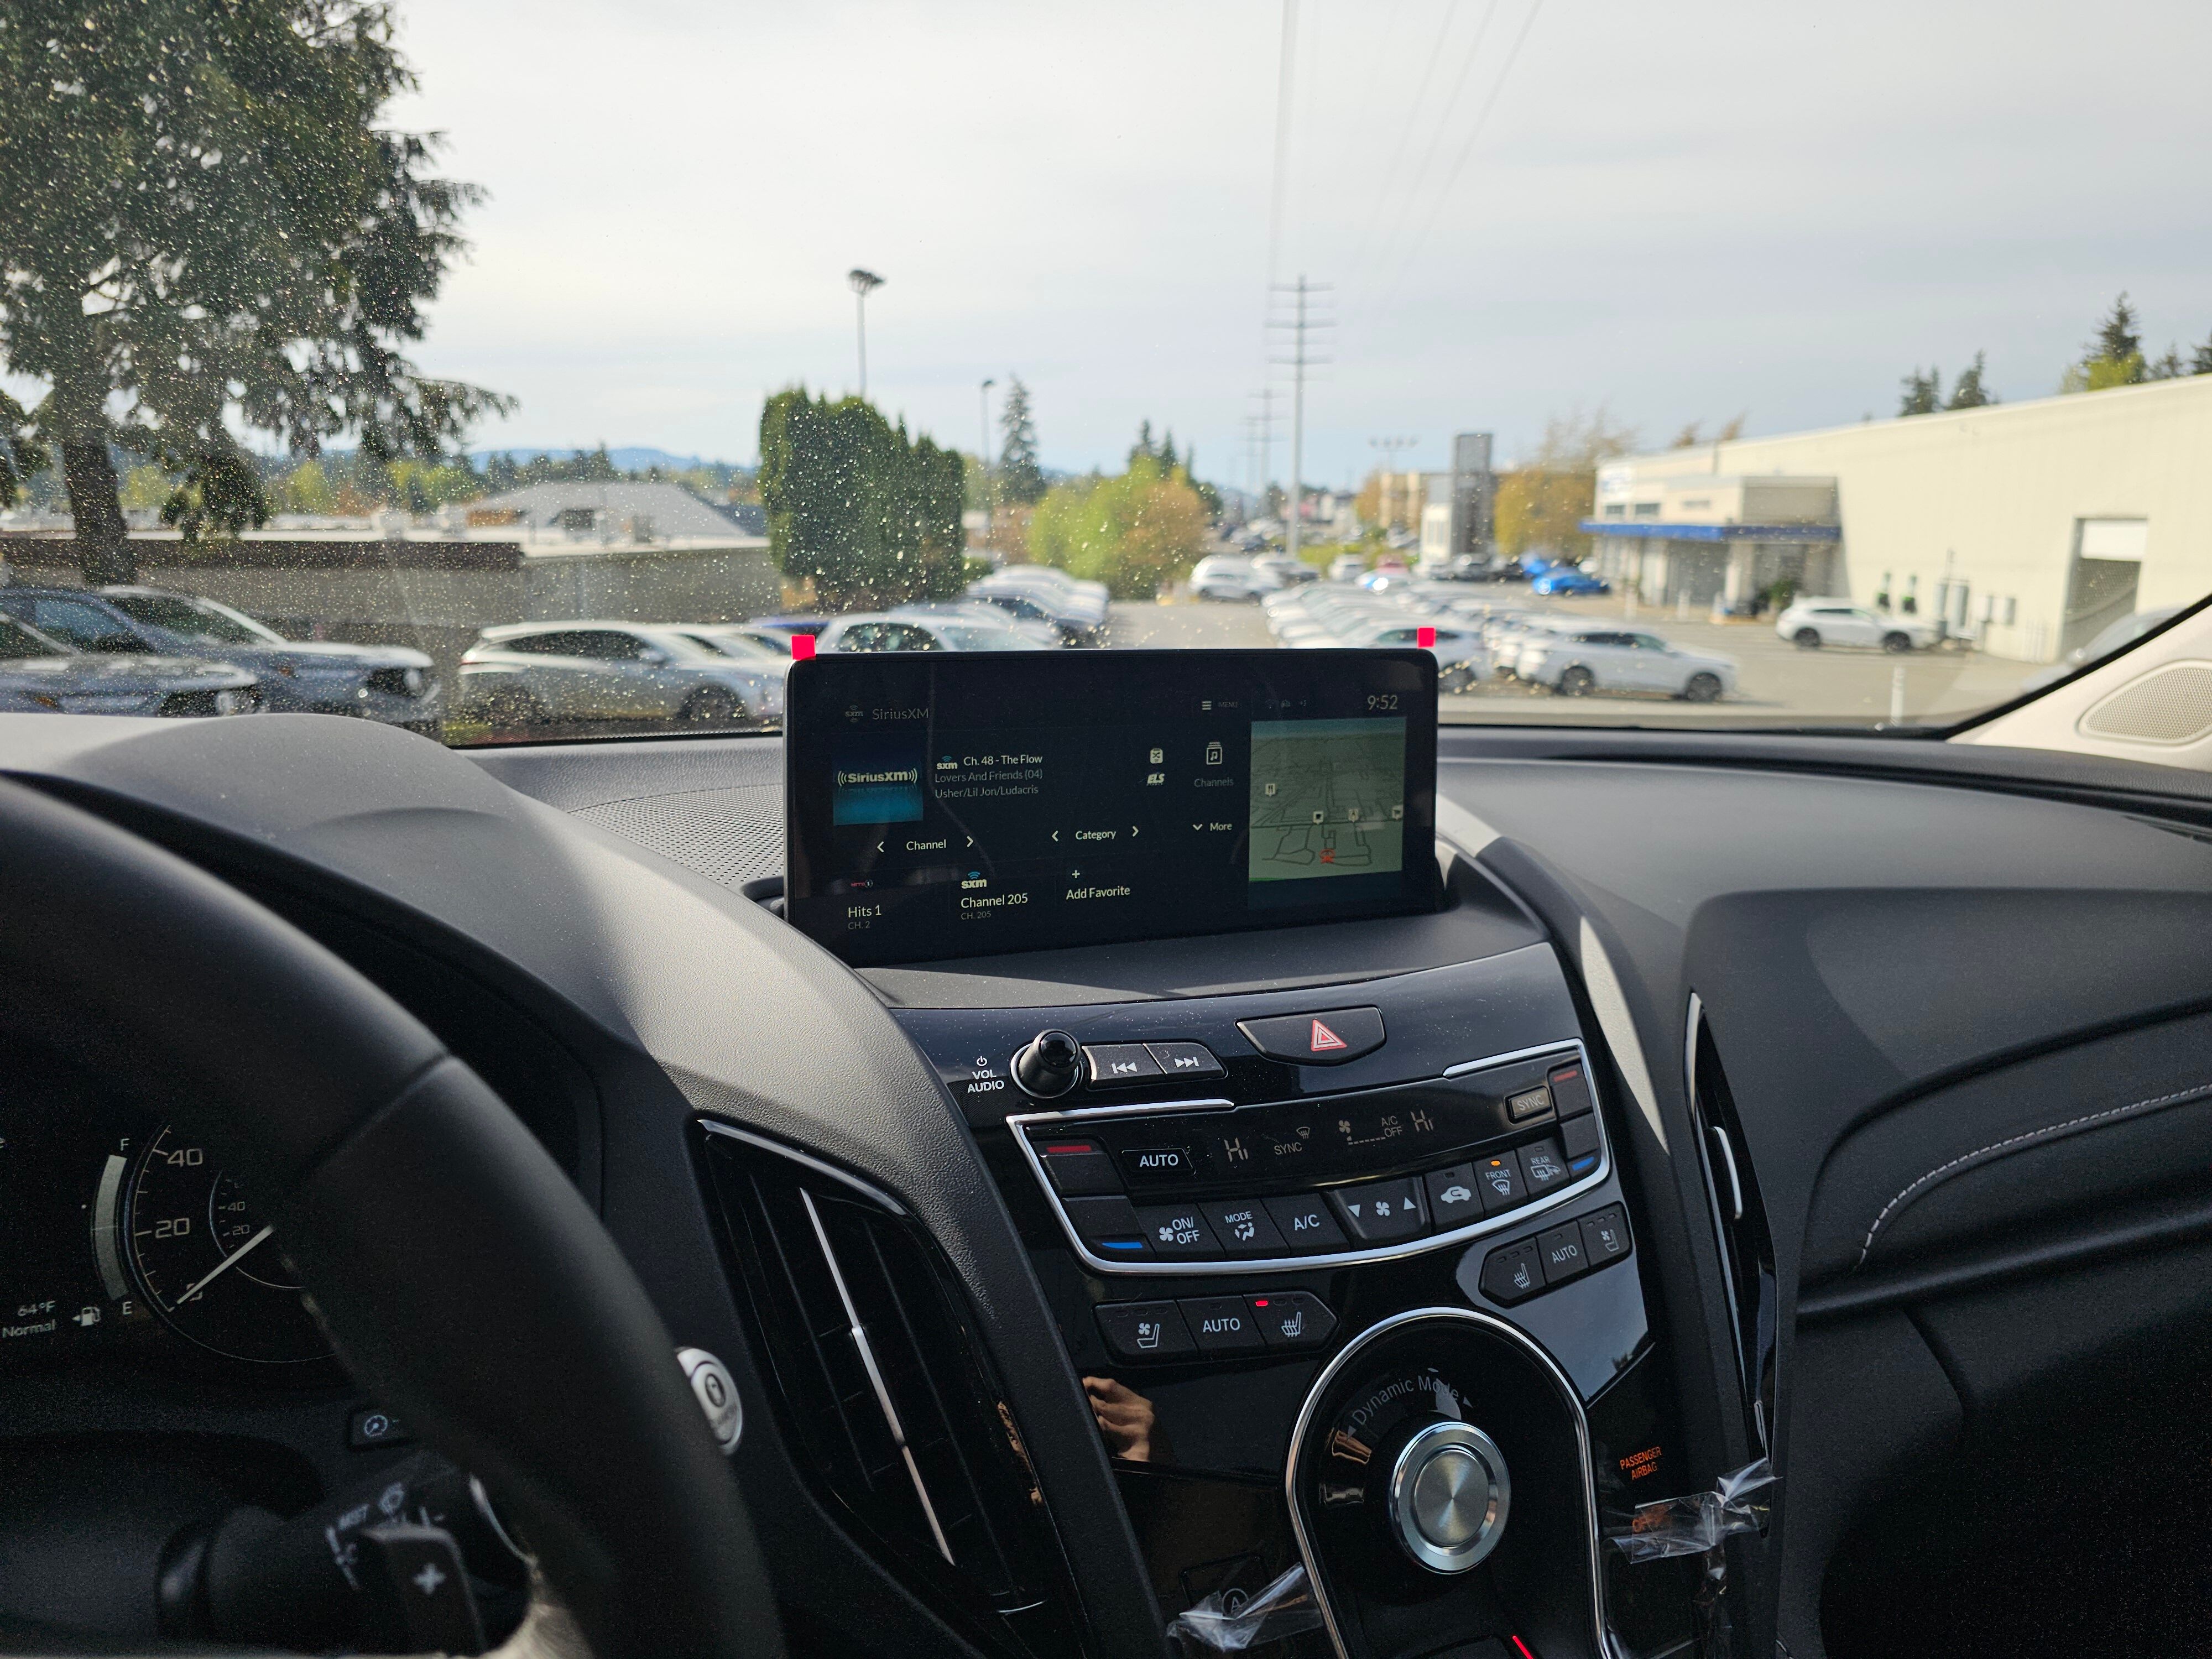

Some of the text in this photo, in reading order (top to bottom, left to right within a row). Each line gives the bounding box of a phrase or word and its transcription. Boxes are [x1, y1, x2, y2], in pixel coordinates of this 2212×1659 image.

[1367, 694, 1399, 710] 9:52
[872, 708, 930, 719] SiriusXM
[936, 761, 958, 770] sxm
[963, 757, 979, 766] Ch.
[981, 757, 994, 765] 48
[1000, 755, 1019, 765] The
[1020, 754, 1044, 764] Flow
[935, 769, 1044, 783] Lovers And Friends (04)
[1146, 773, 1165, 784] ELS
[1194, 777, 1234, 787] Channels
[935, 784, 1039, 799] Usher/Lil Jon/Ludacris
[1209, 822, 1233, 832] More
[1075, 830, 1117, 841] Category
[906, 839, 947, 851] Channel
[961, 879, 987, 889] sxm
[1065, 886, 1131, 900] Add Favorite
[960, 893, 1029, 909] Channel 205
[848, 905, 882, 918] Hits 1
[960, 910, 992, 920] CH. 205
[848, 921, 870, 930] CH. 2
[972, 1069, 997, 1080] VOL
[967, 1080, 1005, 1093] AUDIO
[1516, 1094, 1545, 1111] SYNC
[1381, 1115, 1398, 1126] A/C
[1384, 1125, 1403, 1138] OFF
[120, 1138, 130, 1151] F
[1274, 1142, 1303, 1155] SYNC
[167, 1147, 204, 1168] 40
[1139, 1154, 1179, 1167] AUTO
[1530, 1155, 1551, 1165] REAR
[1484, 1169, 1511, 1181] FRONT
[227, 1201, 246, 1212] 40
[1172, 1216, 1194, 1230] ON/
[1224, 1211, 1254, 1224] MODE
[1294, 1214, 1320, 1230] A/C
[155, 1217, 191, 1239] 20
[232, 1224, 250, 1236] 20
[1176, 1229, 1200, 1244] OFF
[1551, 1245, 1578, 1264] AUTO
[17, 1300, 56, 1317] 64°F
[122, 1301, 133, 1316] E
[1, 1318, 56, 1339] Normal
[1202, 1317, 1241, 1333] AUTO
[1351, 1375, 1459, 1426] Dynamic Mode
[1619, 1446, 1663, 1470] PASSENGER
[1631, 1462, 1658, 1480] AIRBAG
